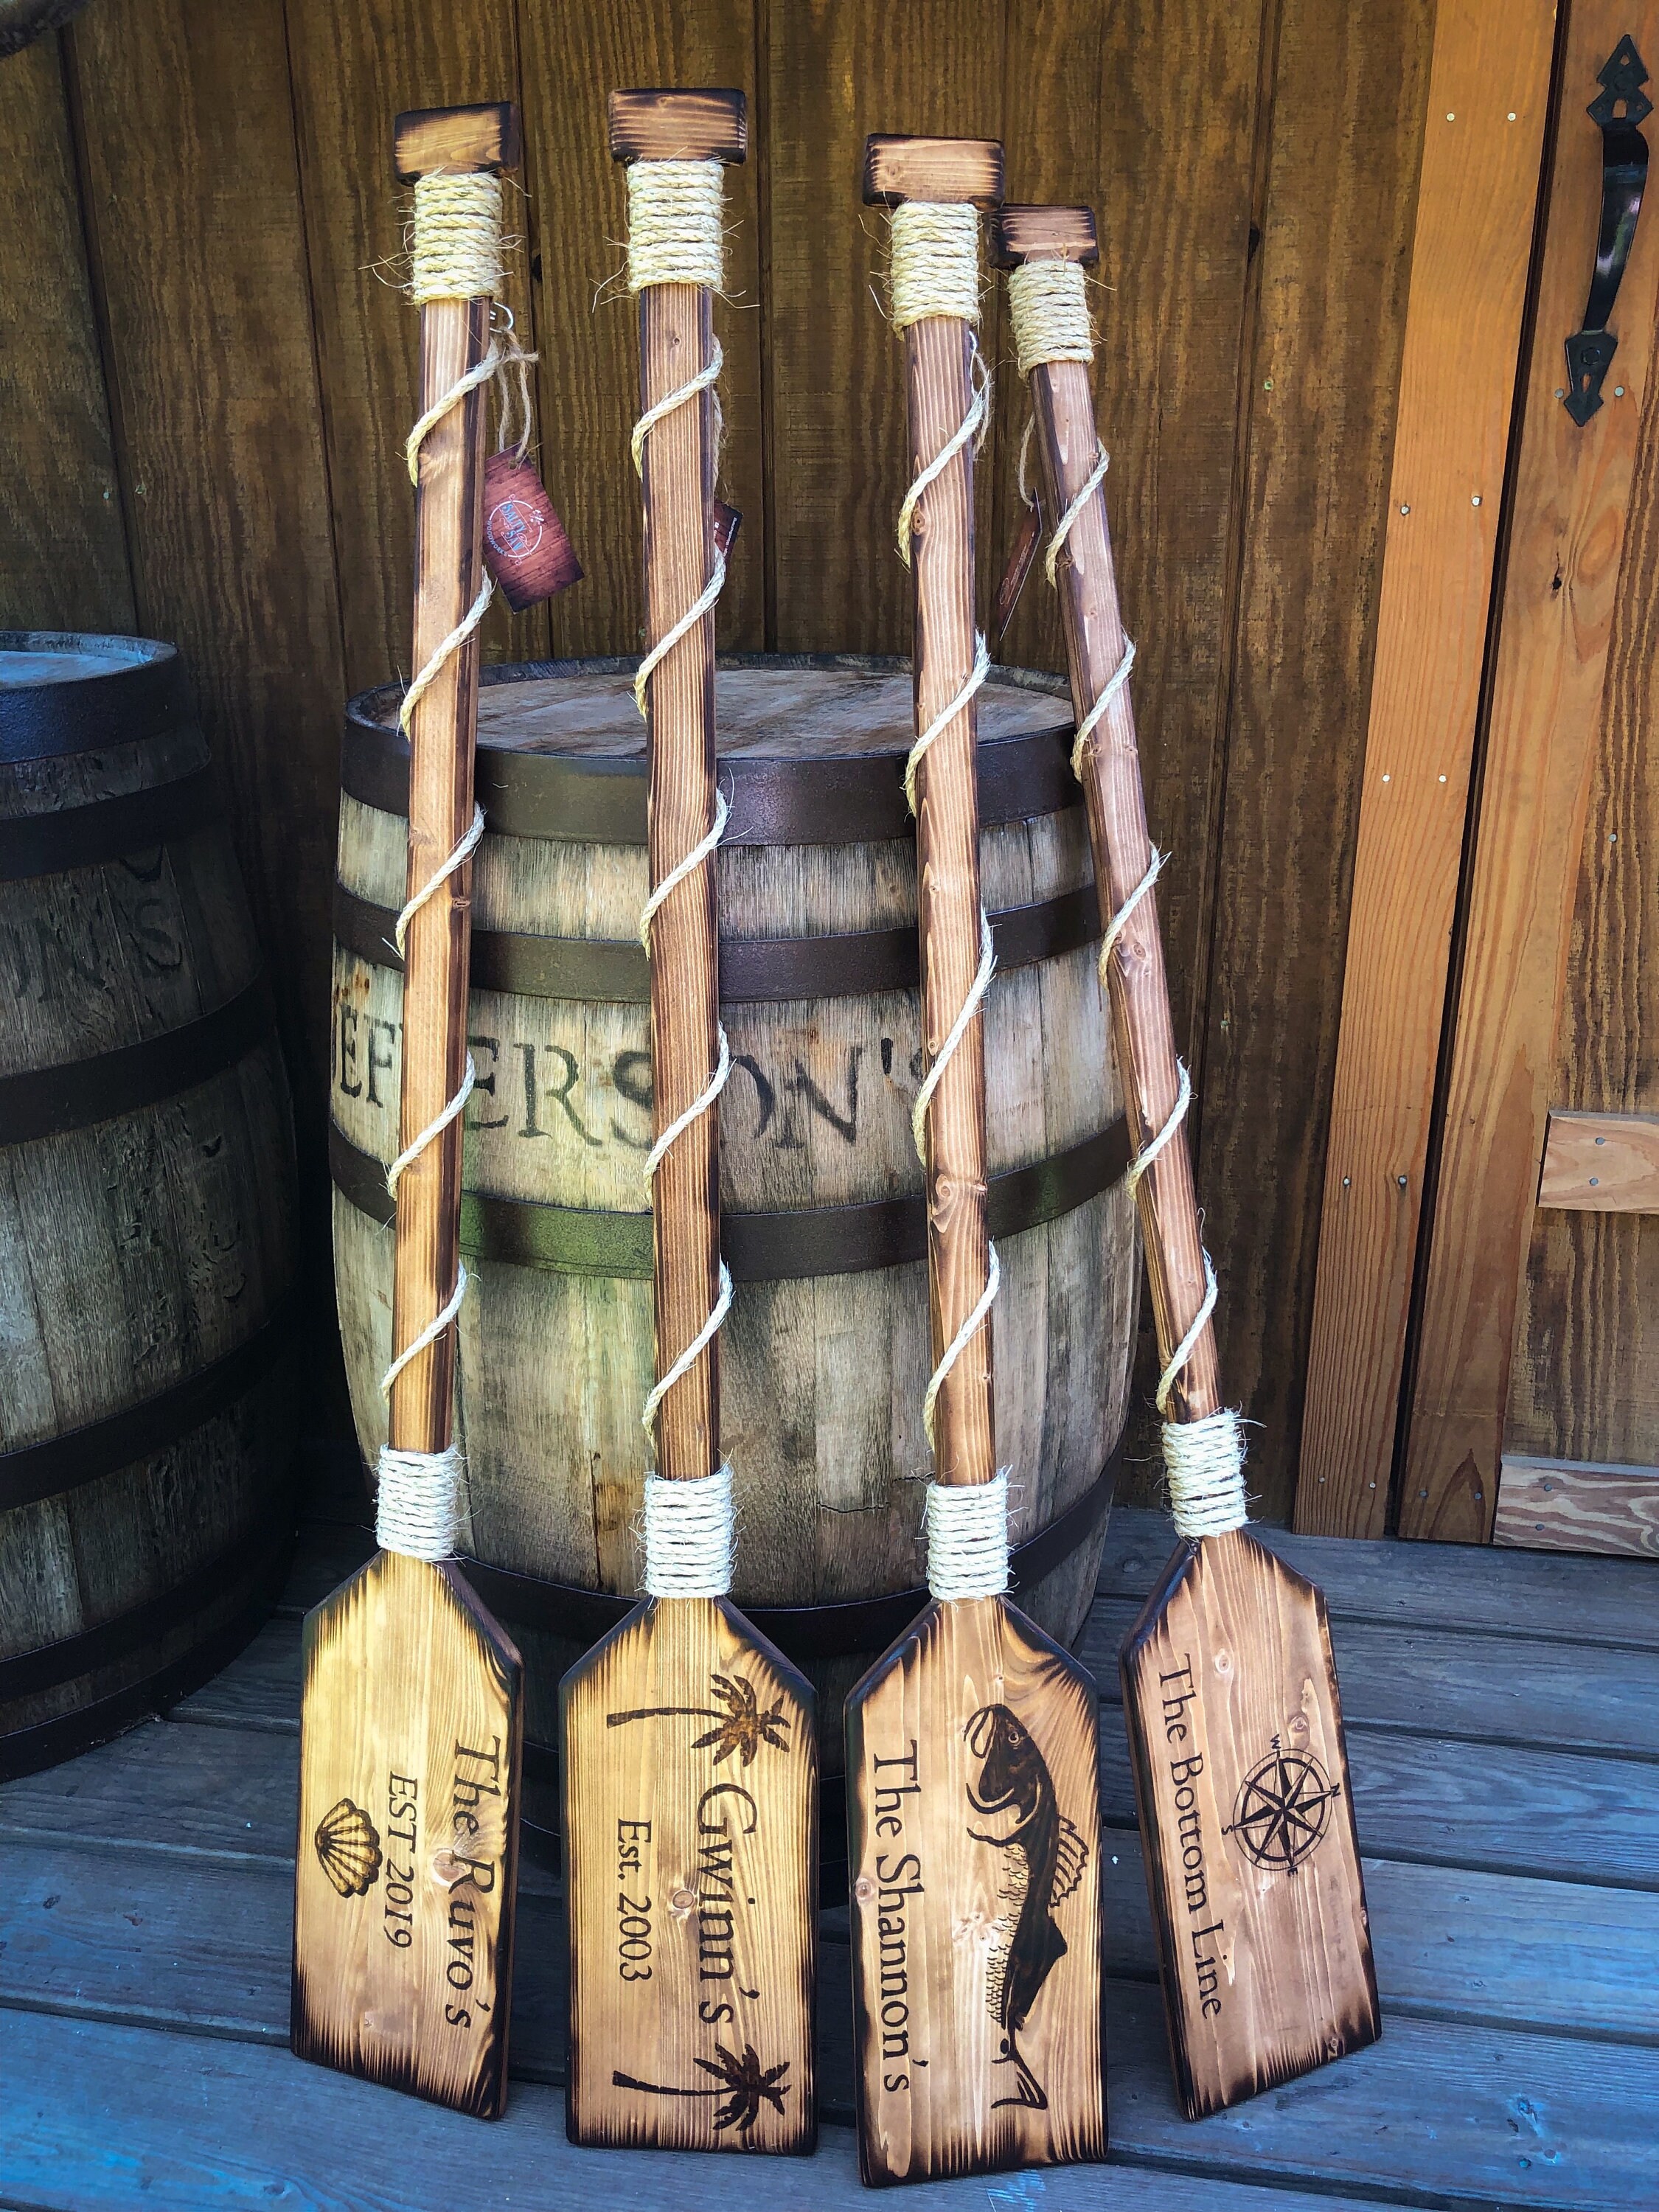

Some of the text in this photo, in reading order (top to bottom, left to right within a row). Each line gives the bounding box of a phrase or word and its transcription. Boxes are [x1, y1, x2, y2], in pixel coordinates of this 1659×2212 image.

[485, 520, 508, 557] WOODWORKS
[501, 503, 526, 532] SALTY
[1270, 1734, 1281, 1749] W
[1330, 1782, 1341, 1798] N
[384, 1770, 418, 1949] EST 2019
[1158, 1653, 1228, 2019] The Bottom Line
[1221, 1824, 1235, 1836] S
[1287, 1867, 1298, 1877] E
[446, 1736, 501, 2029] The Ruvo's
[616, 1818, 653, 1982] Est. 2003
[697, 1783, 760, 2024] Gwinn's
[873, 1739, 928, 2093] The Shannon's
